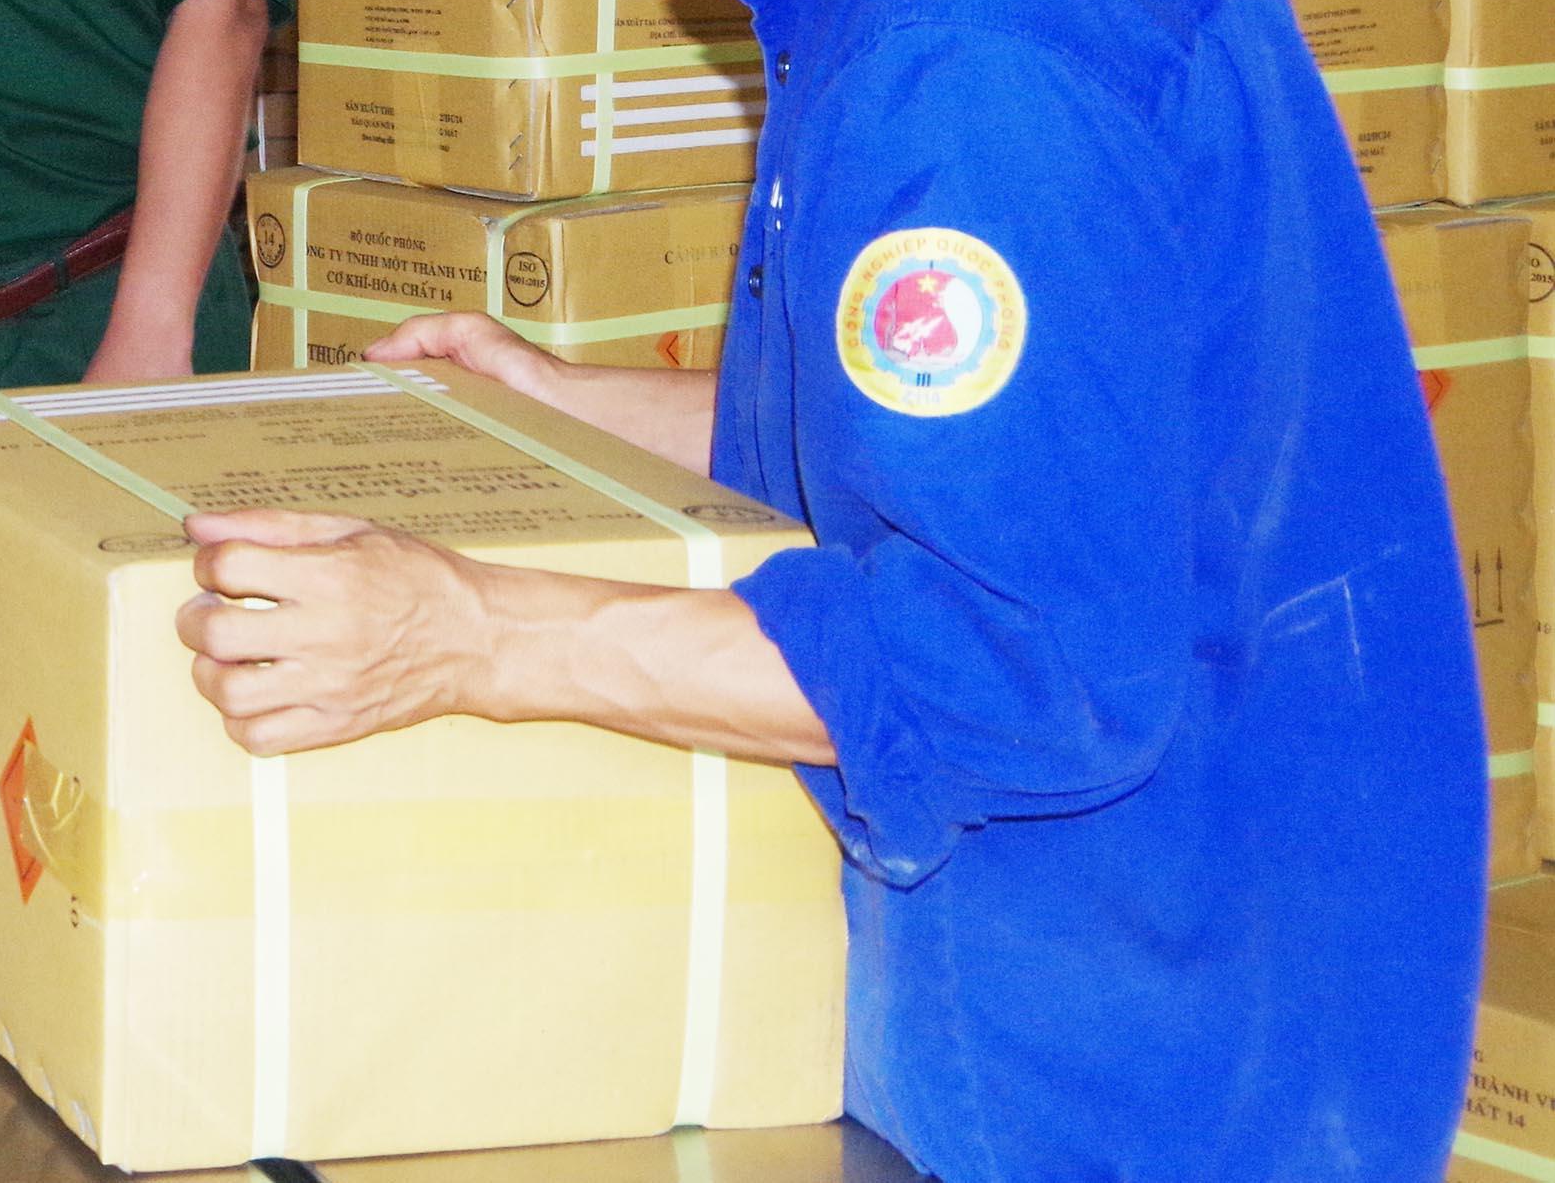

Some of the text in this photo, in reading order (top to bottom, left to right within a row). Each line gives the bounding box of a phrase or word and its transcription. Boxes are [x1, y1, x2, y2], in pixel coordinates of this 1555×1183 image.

[264, 229, 275, 247] 14
[350, 229, 426, 252] BỘ QUỐC PHÒNG
[329, 248, 343, 262] TY
[347, 251, 379, 268] TNHH
[381, 255, 408, 272] MỘT
[411, 259, 456, 280] THÀNH
[518, 260, 536, 273] ISO
[326, 269, 453, 302] CƠ KHÍ-HÓA CHẤT 14
[1507, 1111, 1526, 1129] 14
